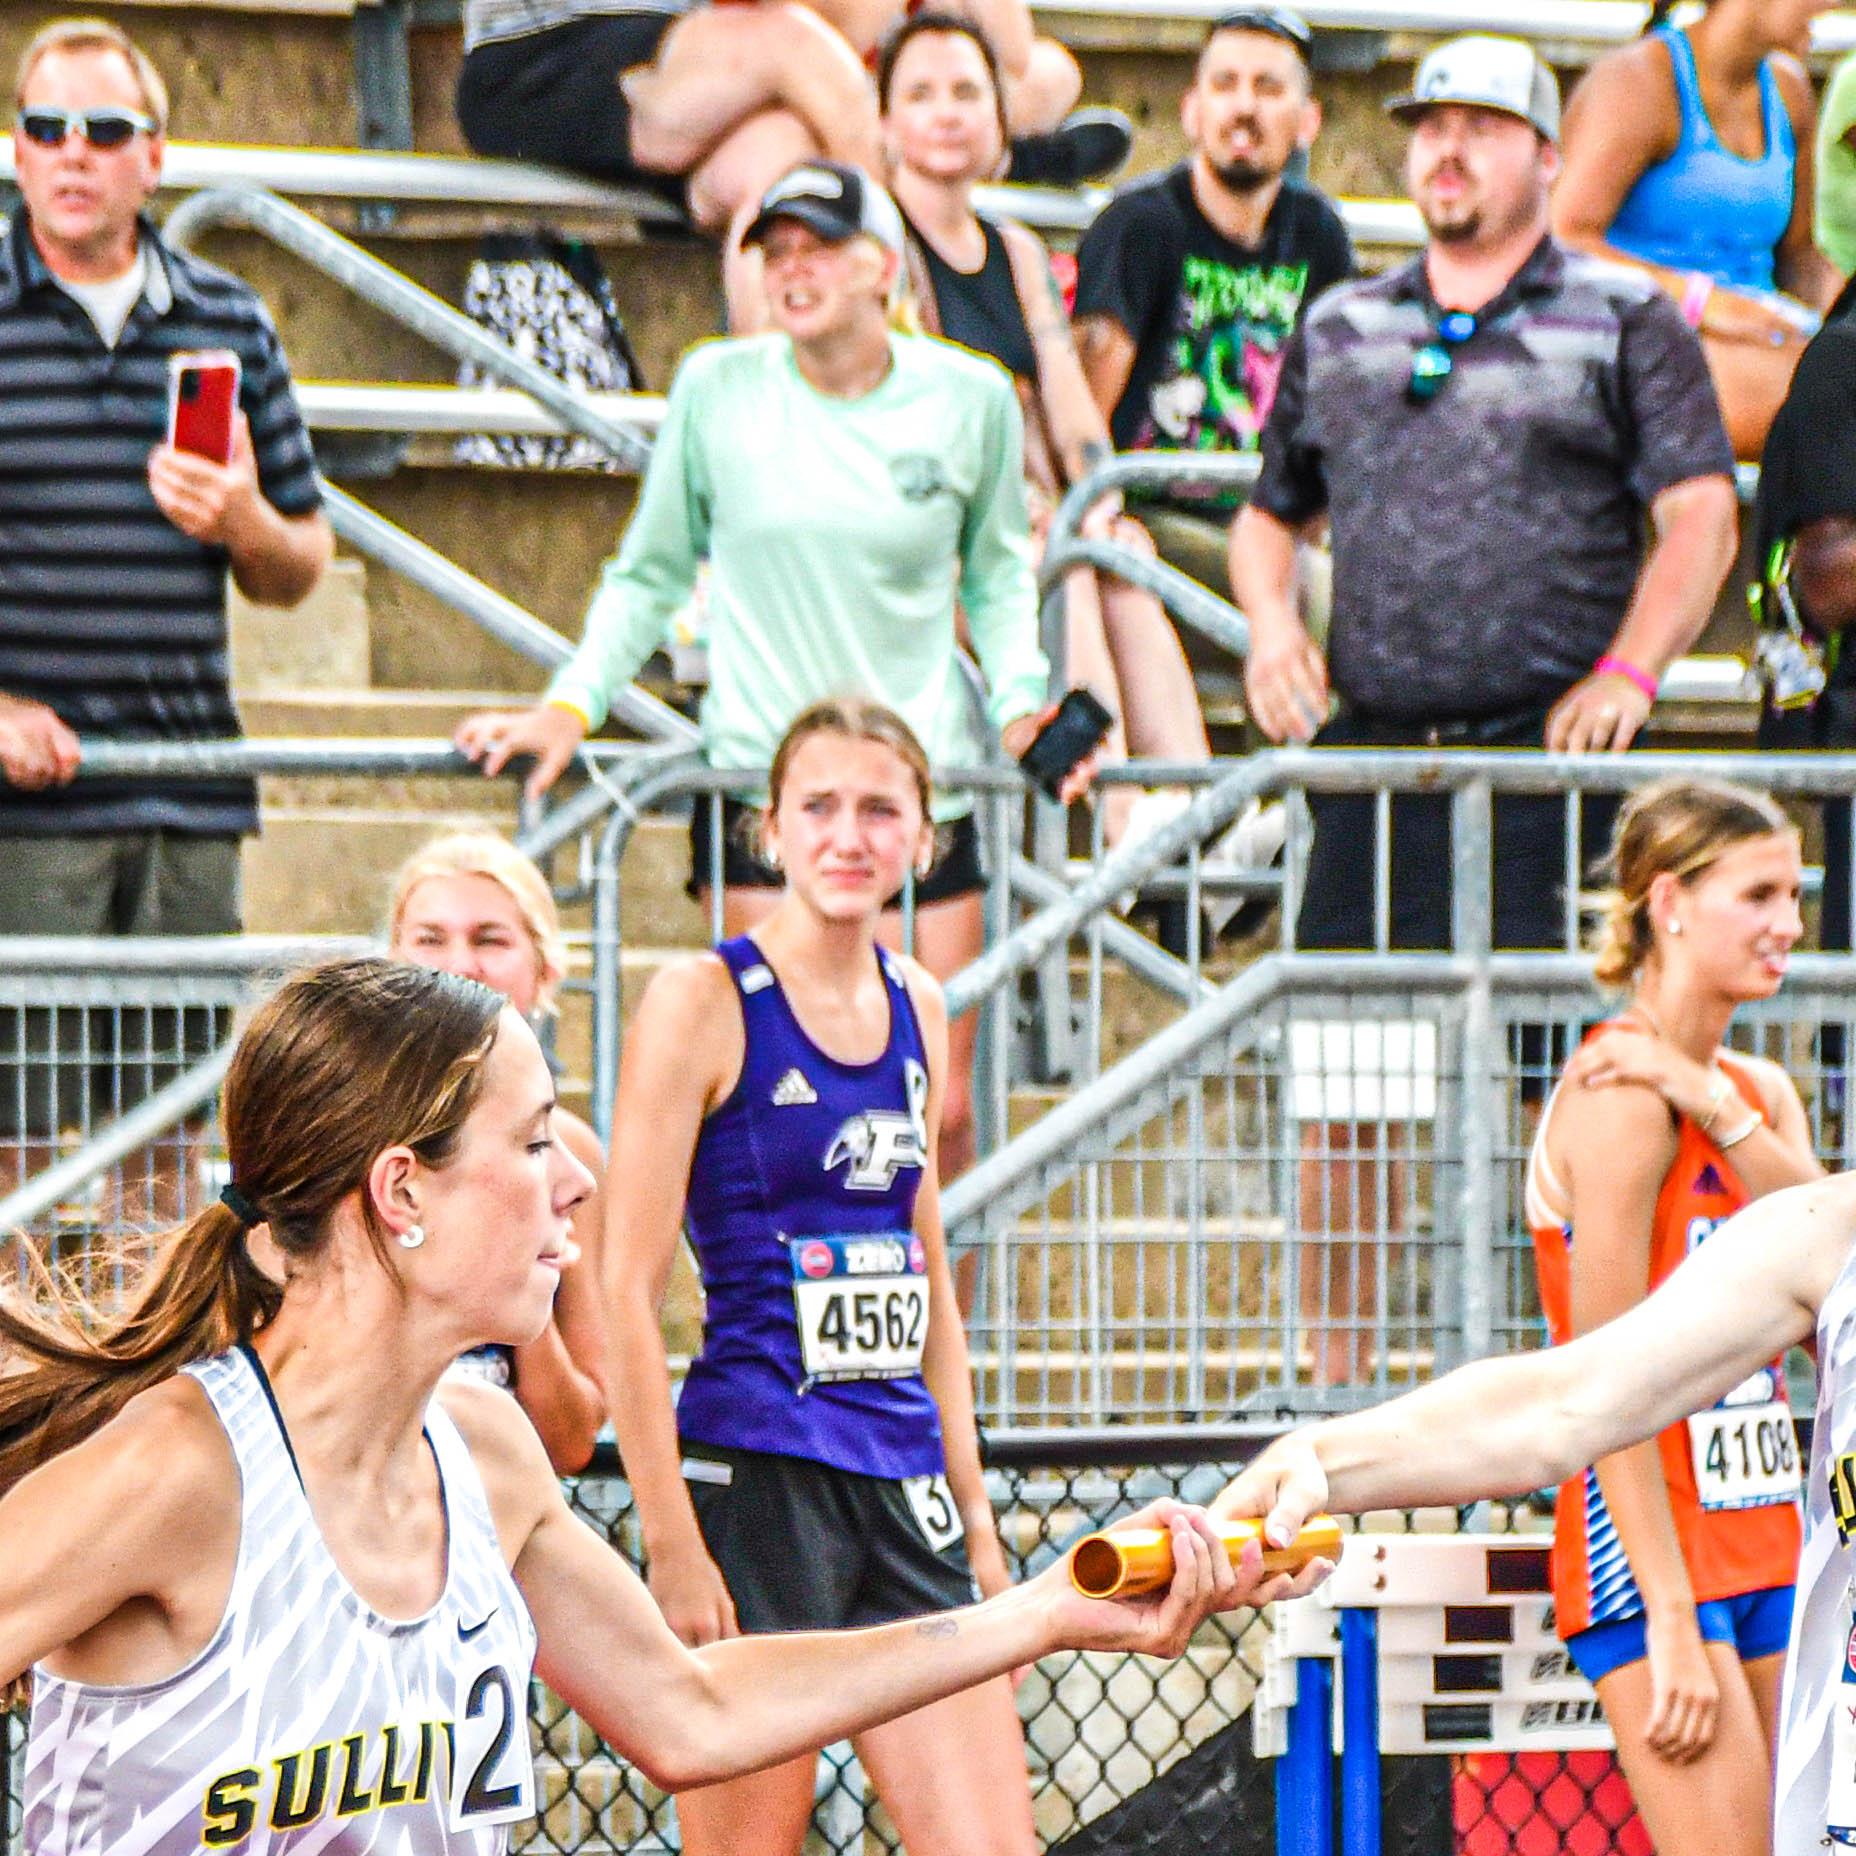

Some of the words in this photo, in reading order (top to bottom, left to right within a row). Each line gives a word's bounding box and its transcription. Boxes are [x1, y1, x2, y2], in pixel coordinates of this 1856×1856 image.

[817, 1290, 924, 1354] 4562
[1706, 1418, 1795, 1482] 4108
[201, 1721, 456, 1849] SULLI
[460, 1664, 523, 1819] 2
